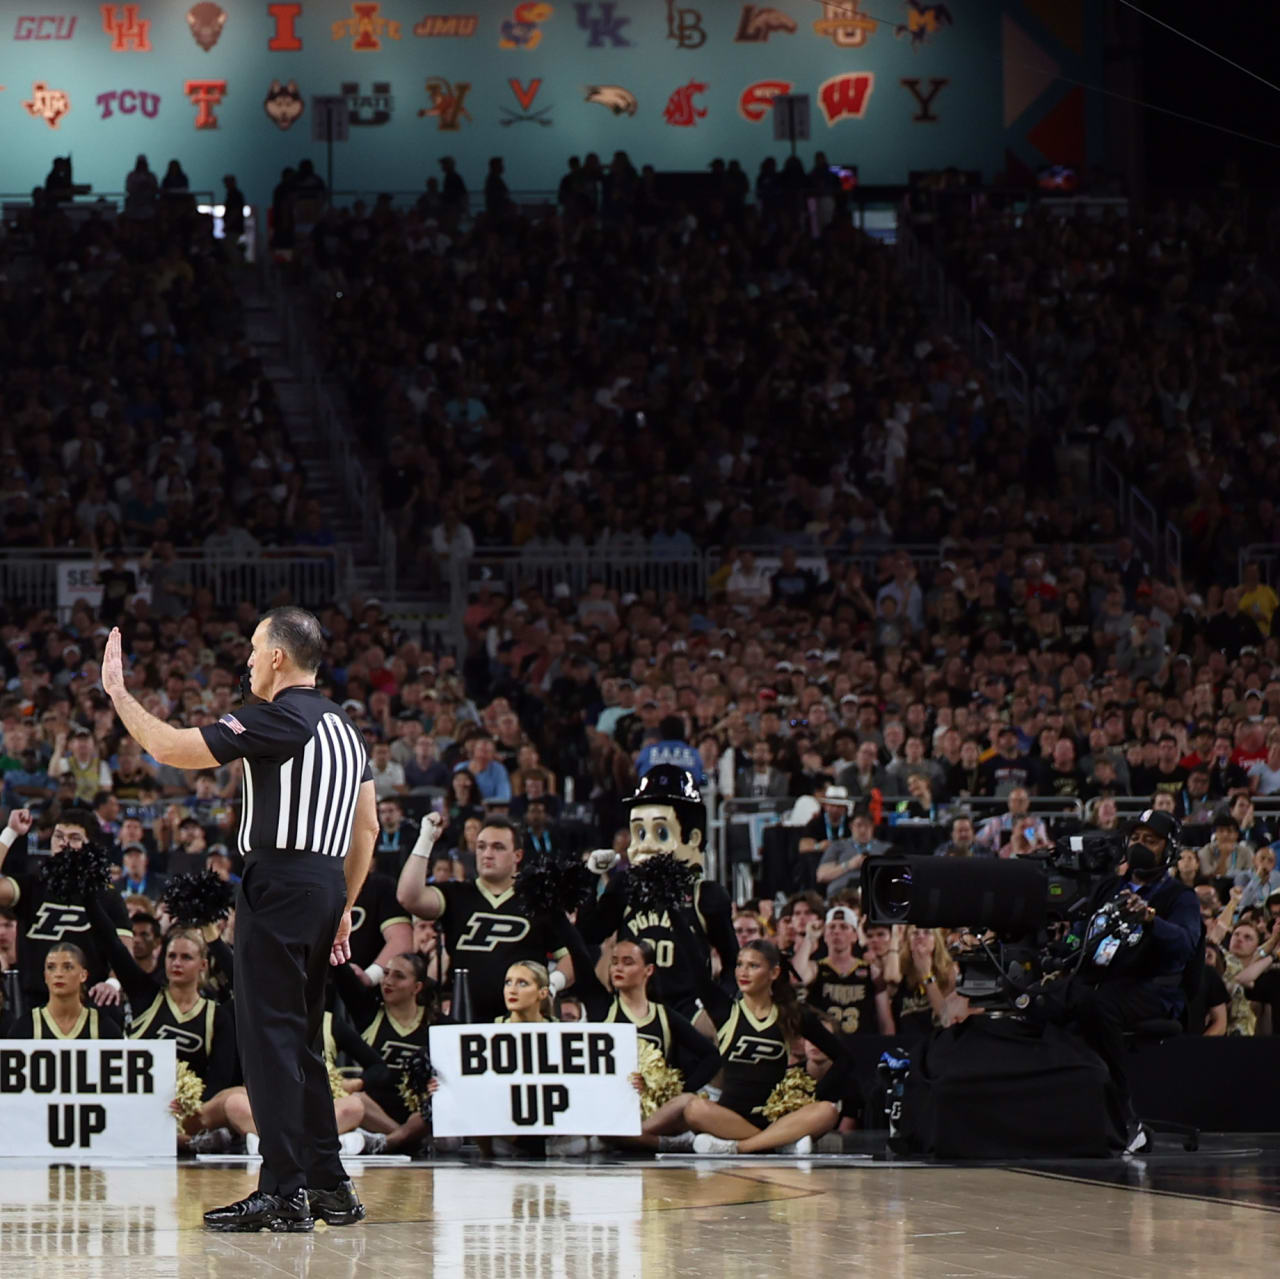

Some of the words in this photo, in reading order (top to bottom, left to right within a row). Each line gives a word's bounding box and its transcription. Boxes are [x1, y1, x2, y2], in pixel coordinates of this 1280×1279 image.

[13, 16, 78, 41] GCU
[95, 89, 162, 120] TCU
[460, 1031, 617, 1076] BOILER
[47, 1103, 106, 1149] UP
[510, 1083, 570, 1126] UP
